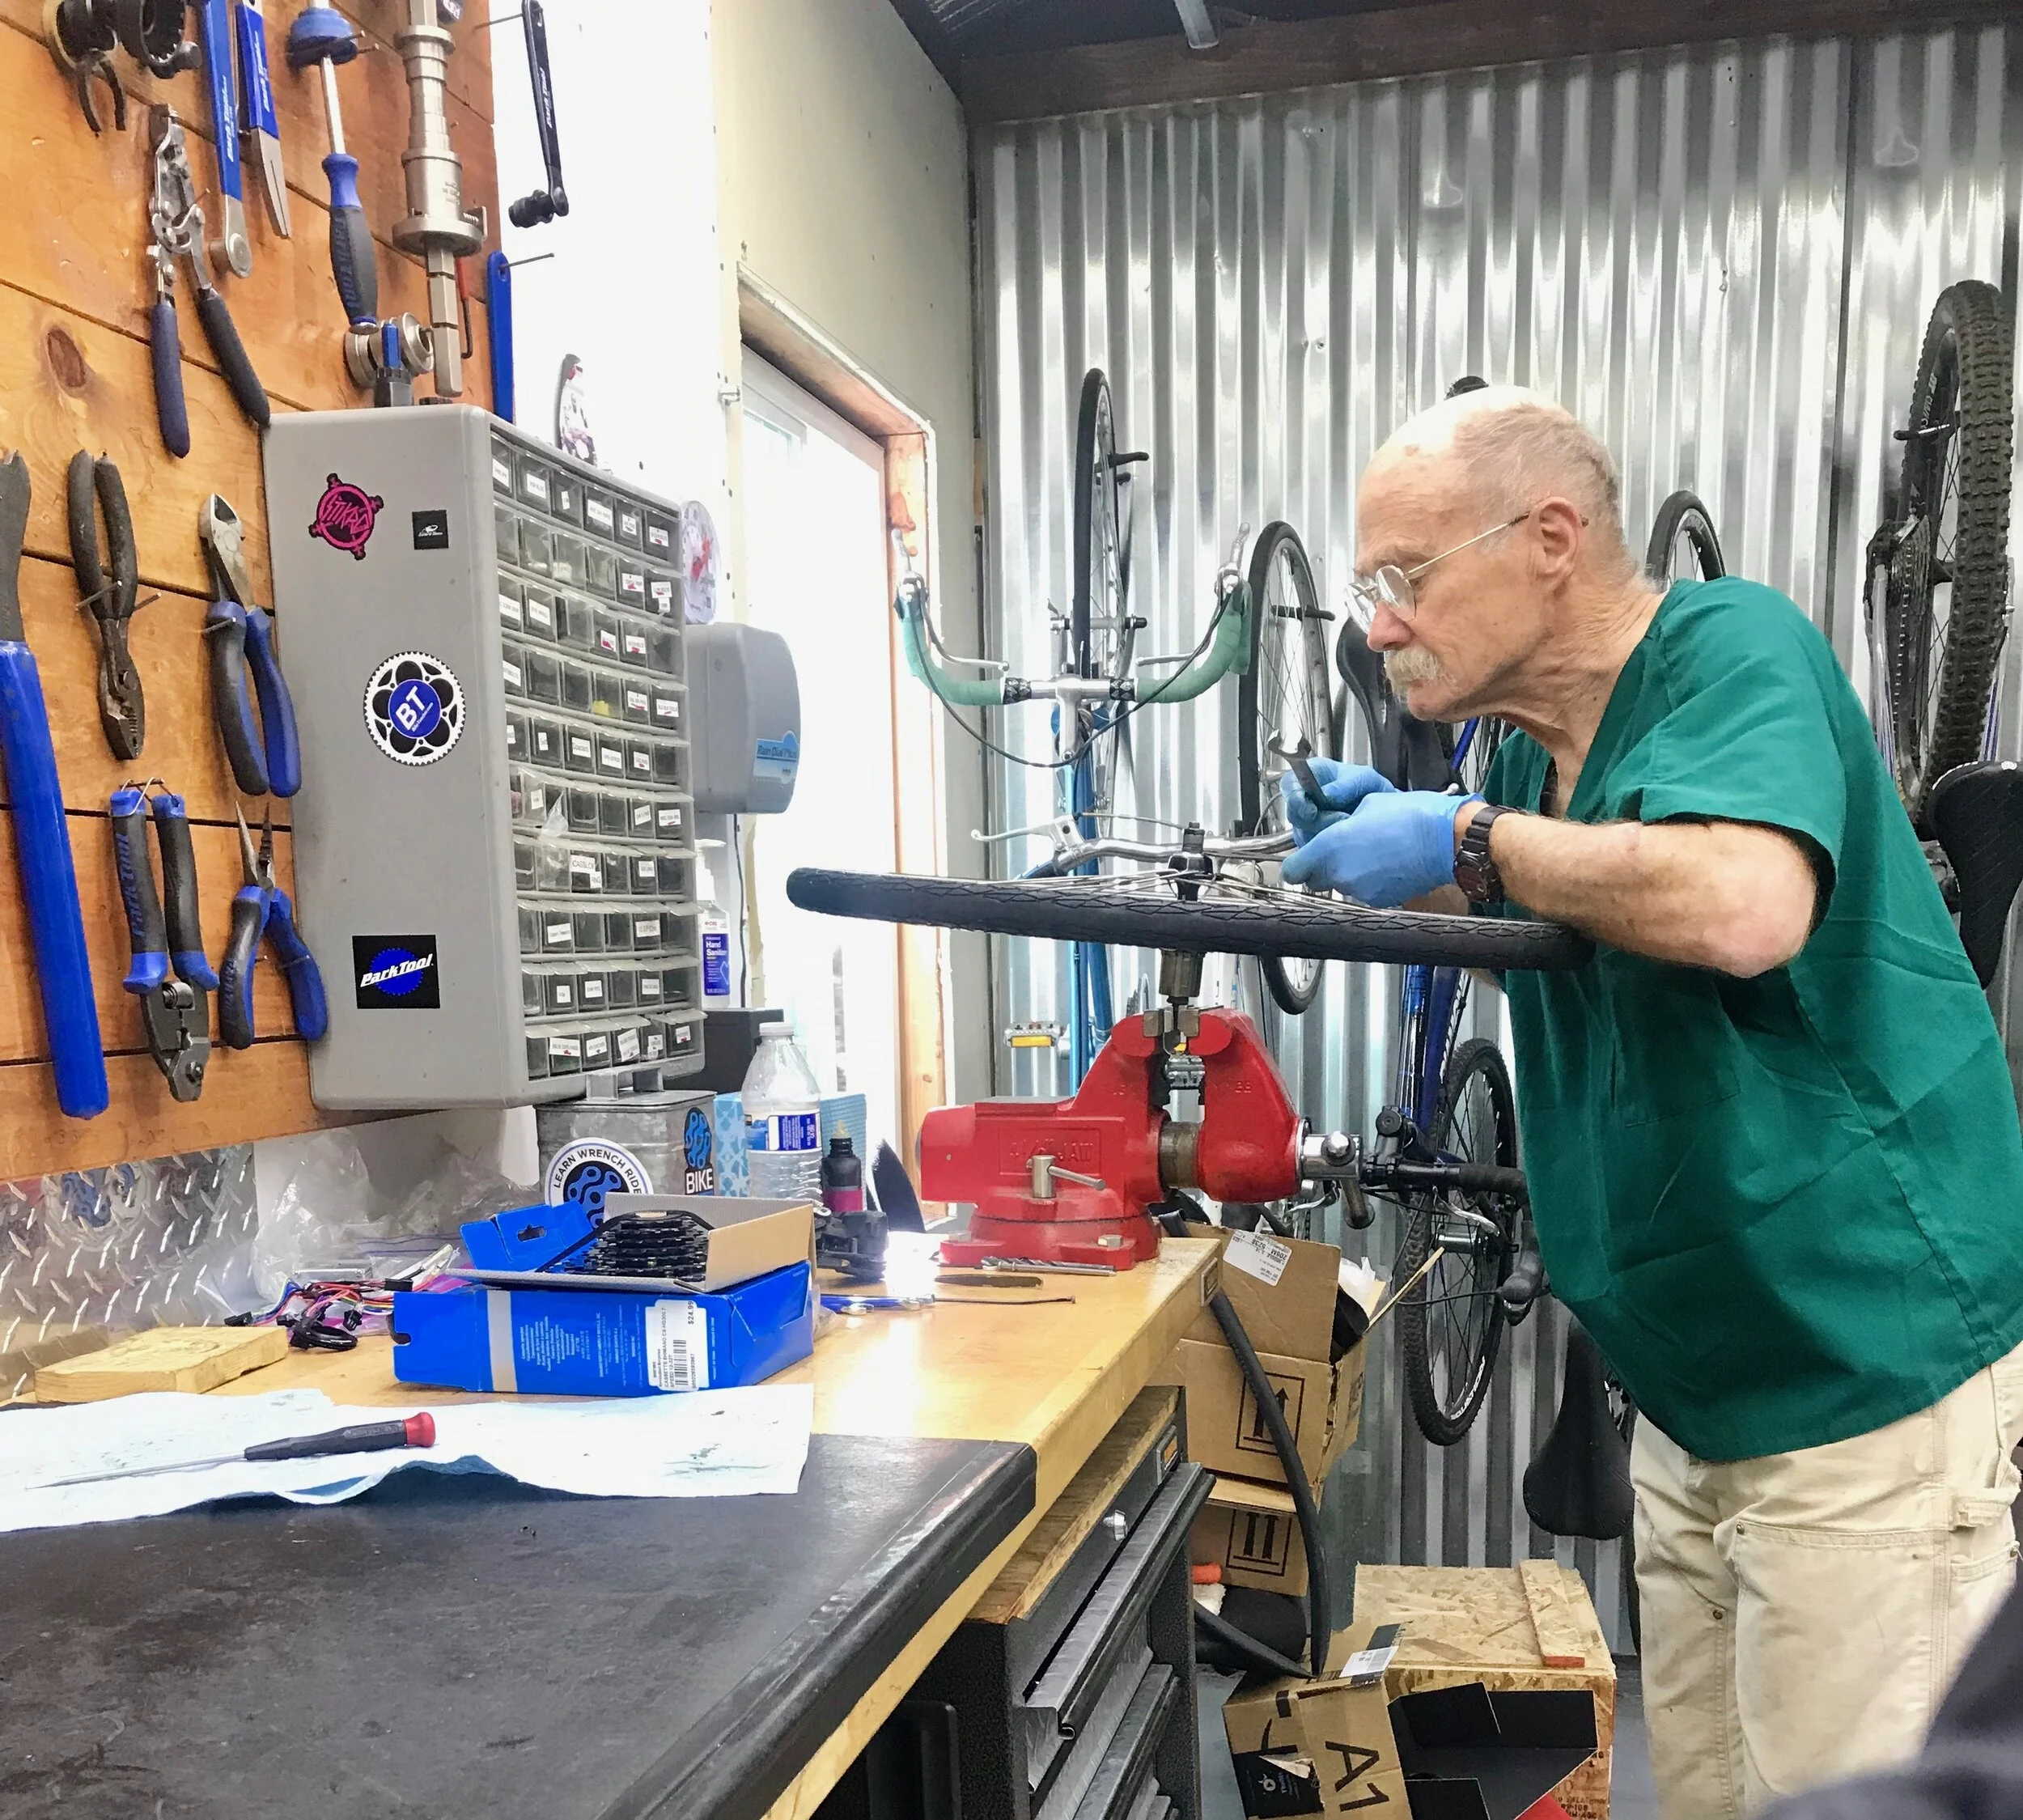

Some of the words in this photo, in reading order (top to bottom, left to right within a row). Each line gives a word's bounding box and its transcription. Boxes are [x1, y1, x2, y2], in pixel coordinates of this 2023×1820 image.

[395, 685, 426, 731] BT
[360, 953, 433, 988] ParkTool
[706, 948, 727, 957] Sanitizer
[553, 1155, 576, 1189] LEARN
[577, 1148, 626, 1169] WRENCH
[625, 1169, 643, 1194] RIDE
[686, 1168, 714, 1194] BIKE
[1325, 1741, 1389, 1812] A1
